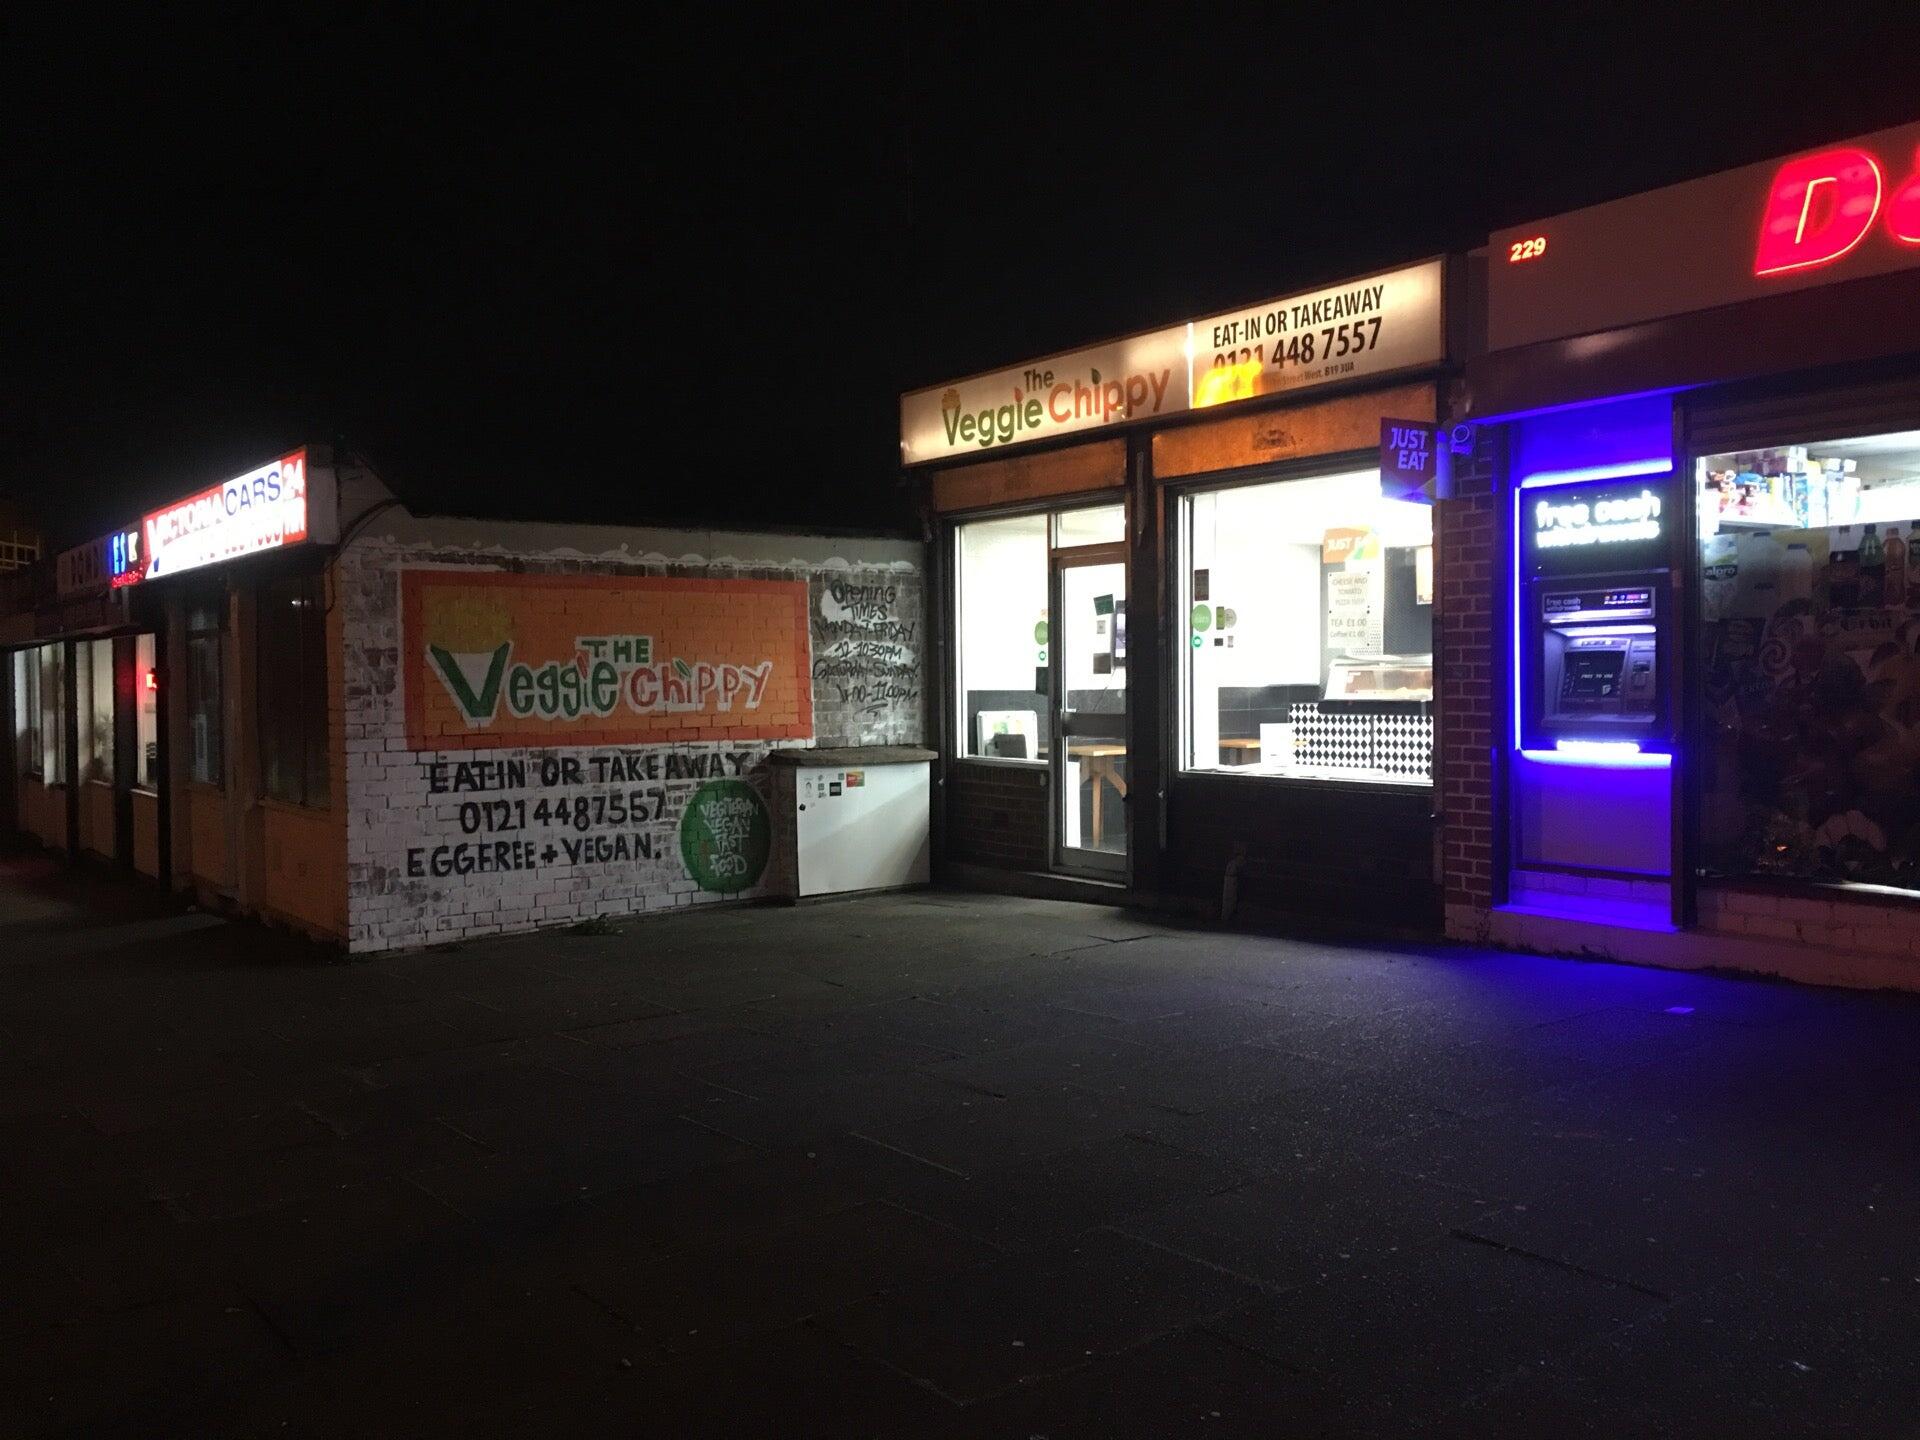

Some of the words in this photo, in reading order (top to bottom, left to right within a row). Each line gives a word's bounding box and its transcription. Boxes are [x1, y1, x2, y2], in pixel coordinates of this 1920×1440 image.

[1755, 142, 1920, 275] D
[1510, 237, 1546, 262] 229
[1213, 316, 1261, 348] EAT-IN
[1265, 310, 1288, 335] OR
[1291, 284, 1384, 330] TAKEAWAY
[1271, 332, 1315, 370] 448
[1321, 316, 1383, 360] 7557
[1024, 368, 1054, 392] The
[942, 388, 1043, 447] Veggie
[1048, 368, 1170, 423] Chippy
[1389, 427, 1429, 450] JUST
[1397, 451, 1429, 471] EAT
[225, 471, 282, 517] CARS
[1705, 565, 1736, 578] alpro
[1331, 618, 1343, 627] TEA
[581, 638, 650, 664] THE
[541, 757, 584, 786] OR
[589, 752, 750, 782] TAKEAWAY
